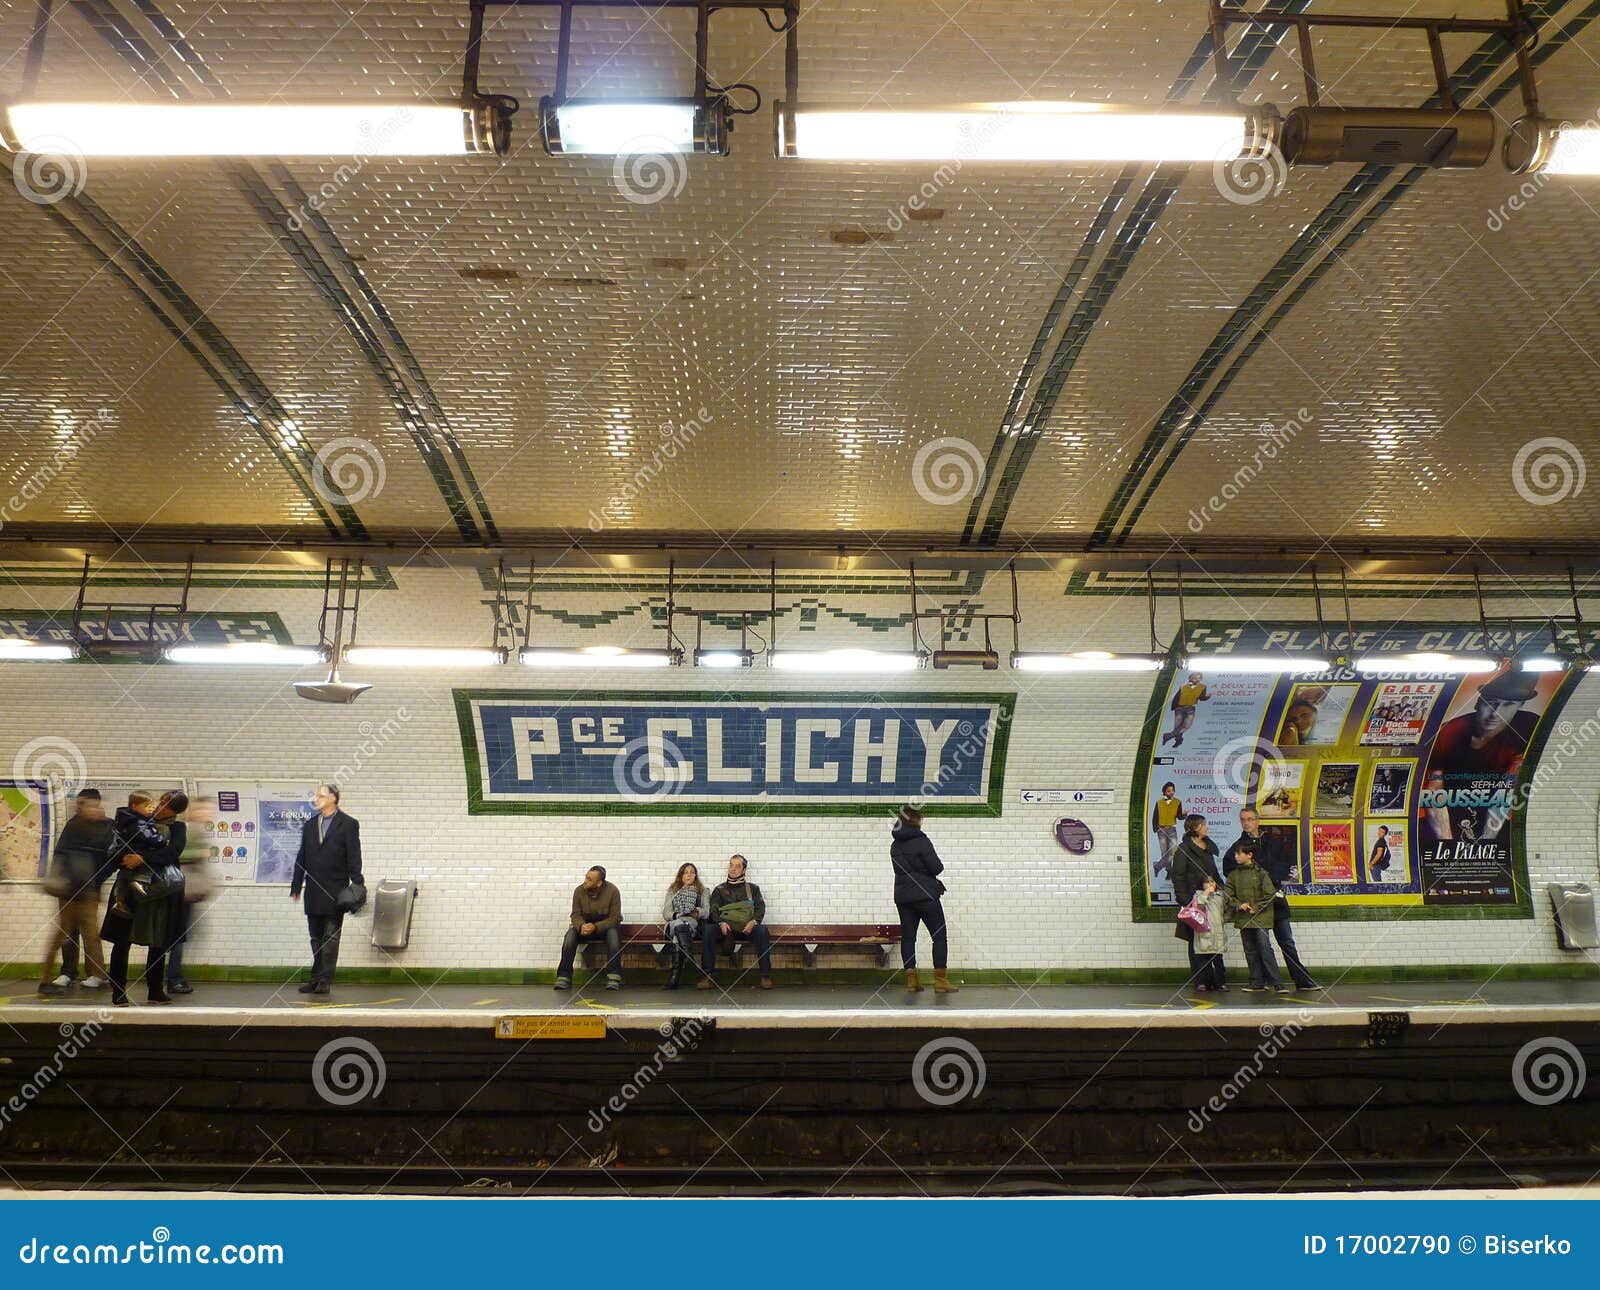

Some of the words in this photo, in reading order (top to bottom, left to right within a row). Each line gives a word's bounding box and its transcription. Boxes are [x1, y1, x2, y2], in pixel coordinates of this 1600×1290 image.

[1263, 630, 1377, 652] PLACE
[1414, 630, 1537, 652] CLICHY
[647, 717, 960, 784] CLICHY
[1372, 785, 1392, 793] FALL
[1420, 789, 1514, 809] ROUSSEAU
[1435, 842, 1450, 859] Le
